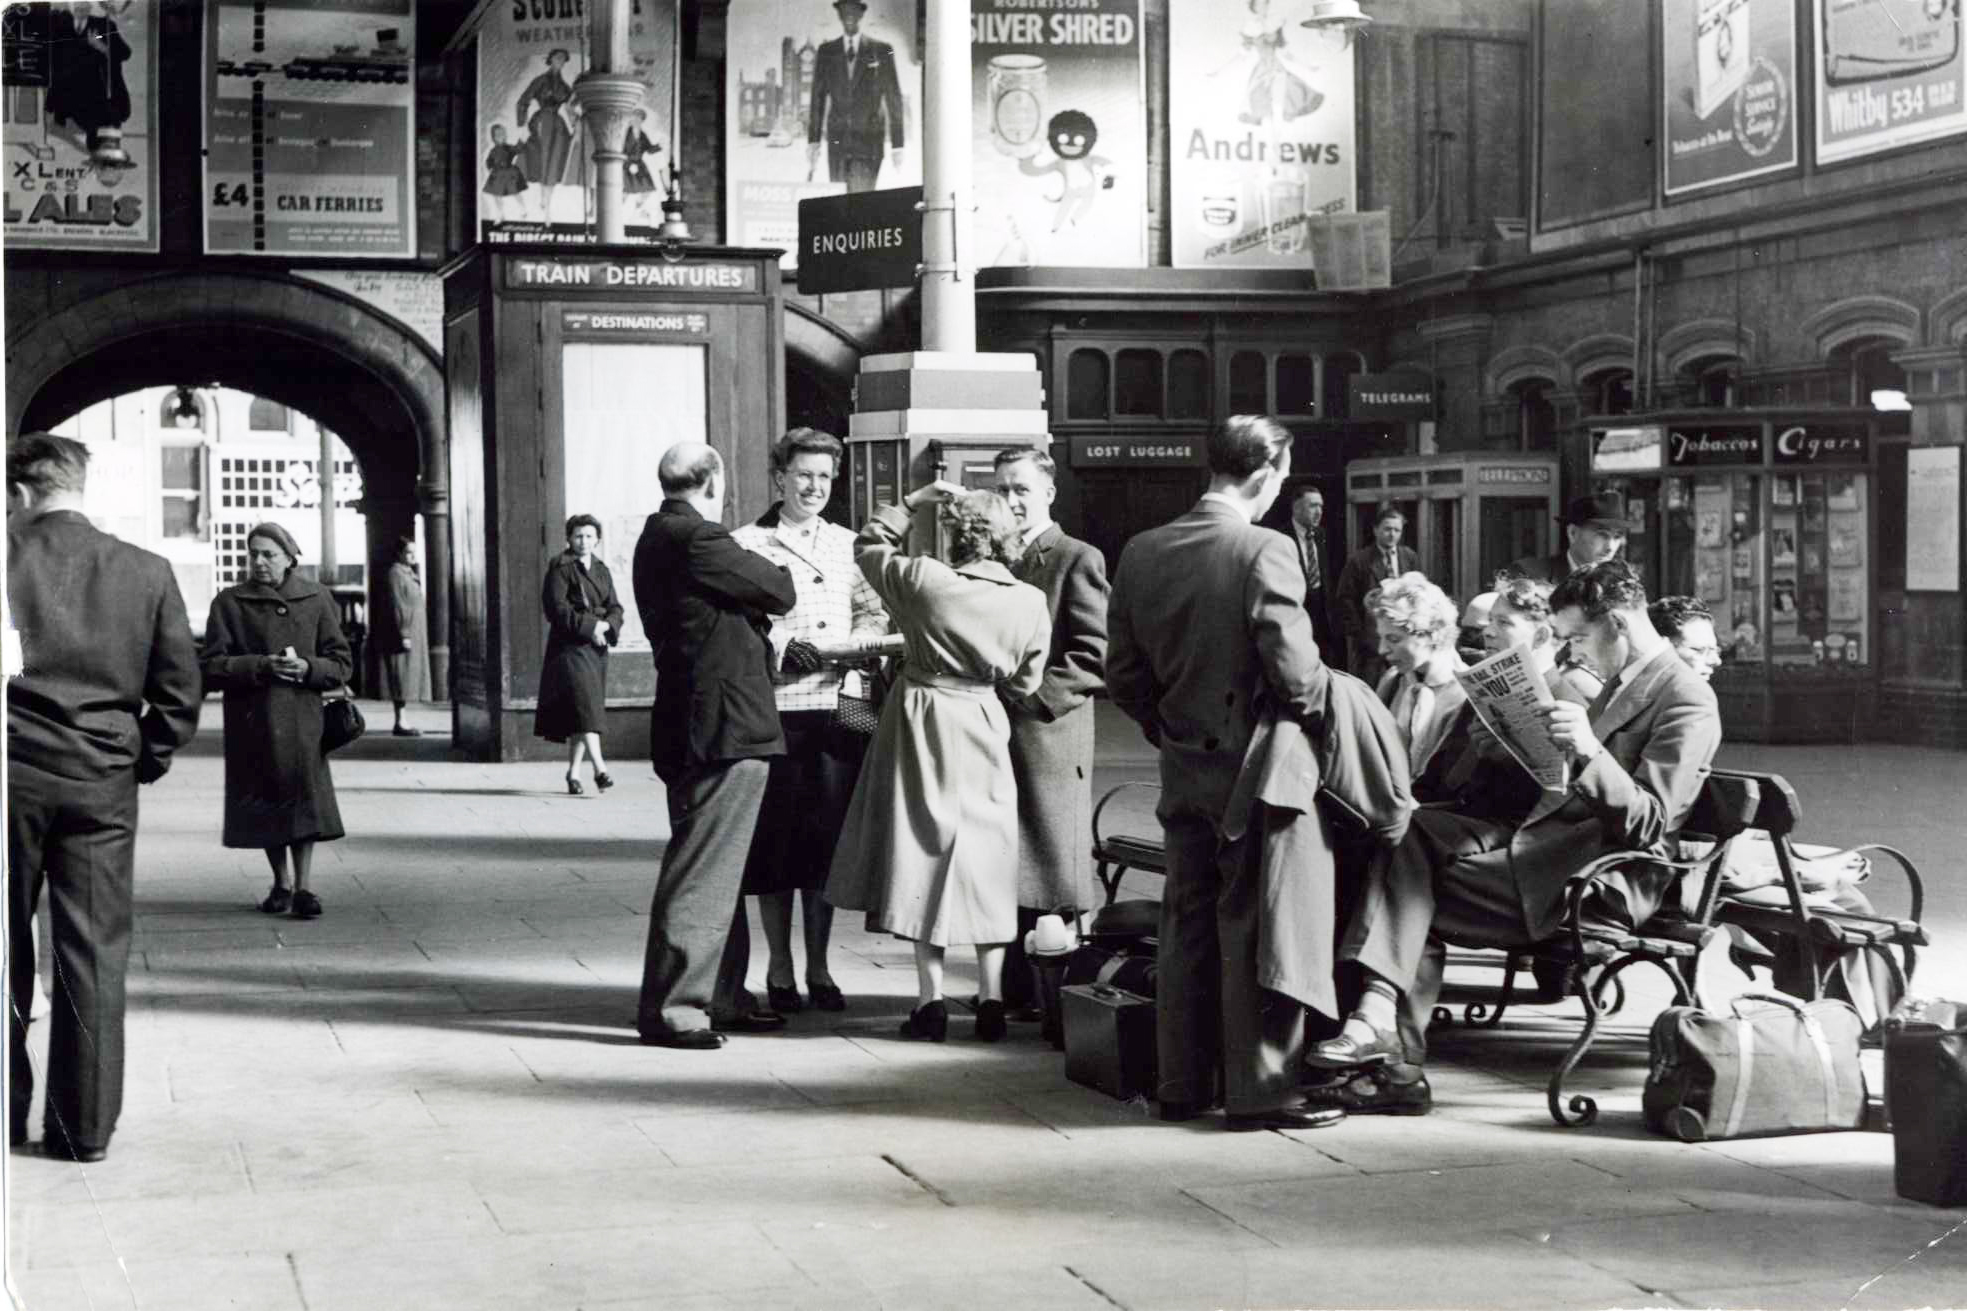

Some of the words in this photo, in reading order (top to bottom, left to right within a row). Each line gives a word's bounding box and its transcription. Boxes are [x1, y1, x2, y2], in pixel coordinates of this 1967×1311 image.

[1049, 13, 1134, 45] SHRED
[1828, 85, 1888, 134] Whitby
[1891, 84, 1925, 120] 534
[1186, 127, 1340, 166] Andrews
[213, 182, 249, 207] £4
[277, 195, 310, 212] CAR
[315, 196, 383, 213] FERRIES
[27, 193, 142, 227] ALES
[813, 228, 903, 254] ENQUIRIES
[521, 265, 590, 284] TRAIN
[606, 265, 742, 288] DEPARTURES
[591, 316, 684, 330] DESTINATIONS
[1360, 392, 1431, 404] TELEGRAMS
[1087, 446, 1120, 457] LOST
[1130, 446, 1192, 457] LUGGAGE
[1671, 432, 1759, 461] Tobaccos
[1777, 427, 1861, 459] Cigars
